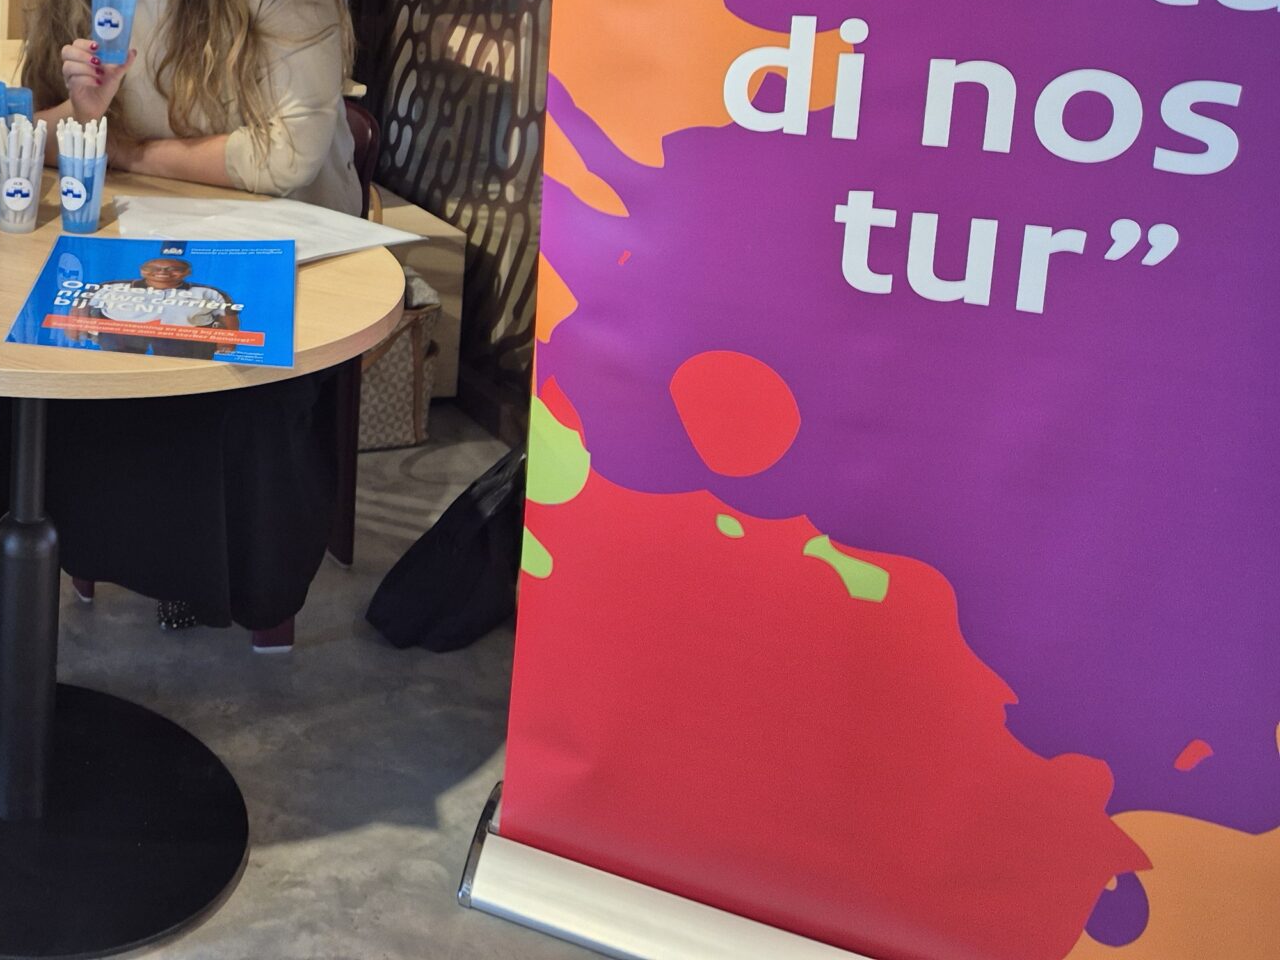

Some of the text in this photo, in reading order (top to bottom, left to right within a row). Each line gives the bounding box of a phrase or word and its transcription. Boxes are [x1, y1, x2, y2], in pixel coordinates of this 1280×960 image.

[723, 14, 1243, 176] di nos
[834, 189, 1180, 315] tur”
[57, 289, 144, 303] nieuwe
[62, 280, 158, 296] Ontdek
[54, 297, 87, 309] bij
